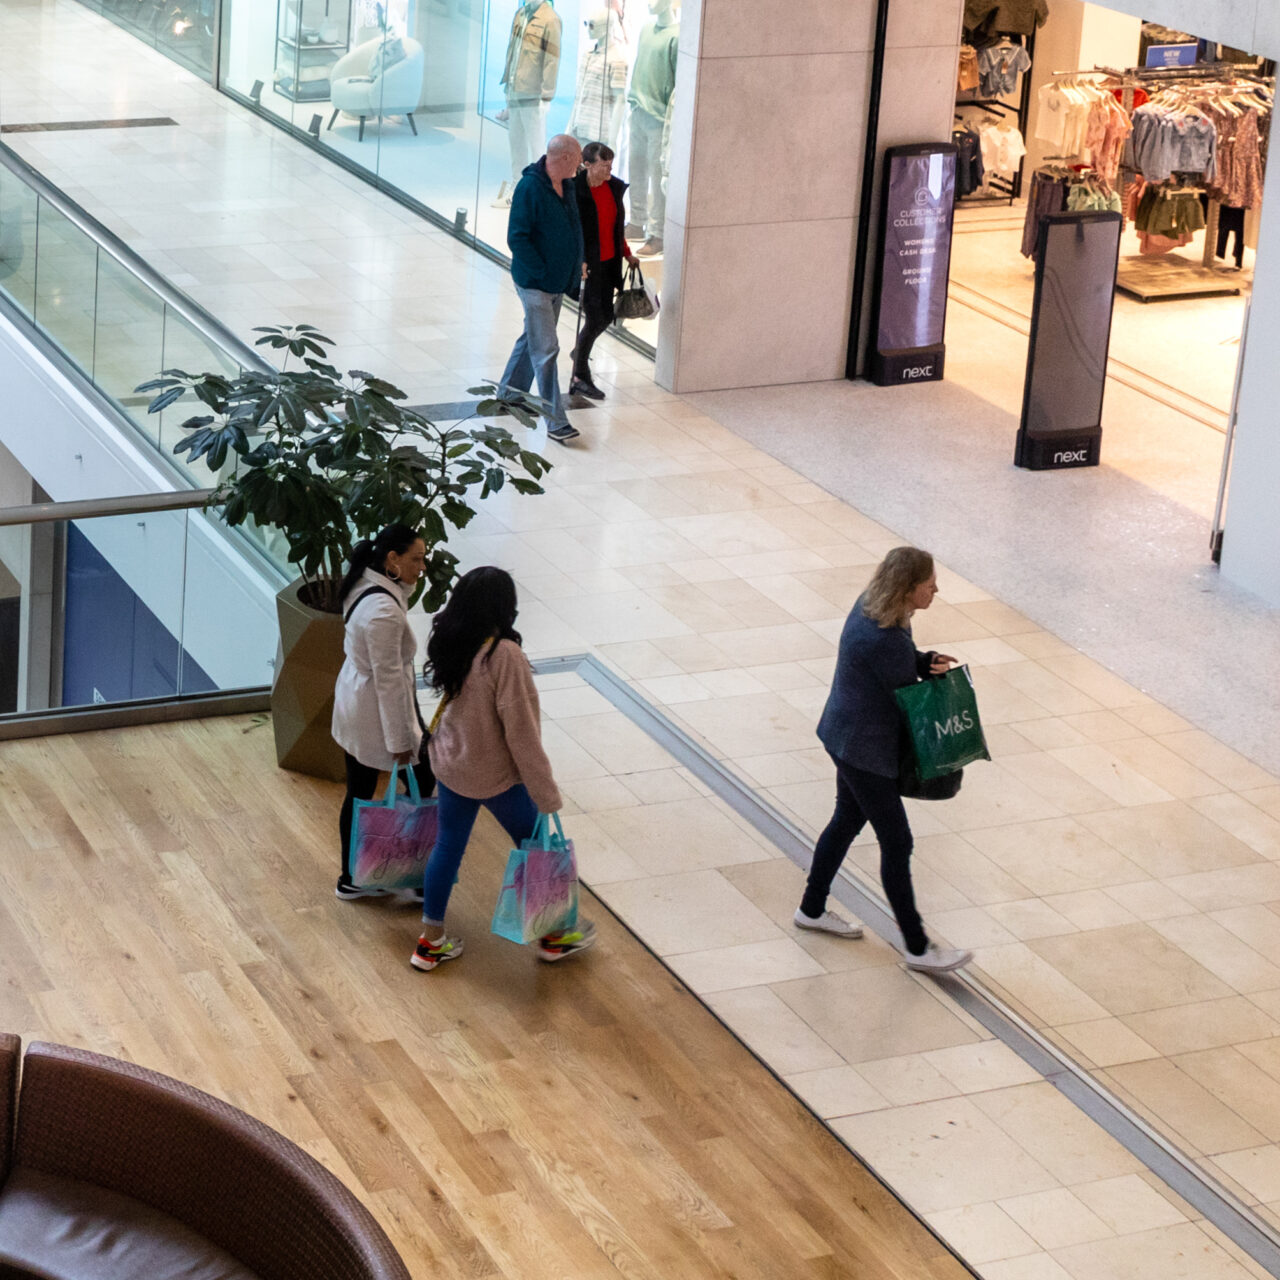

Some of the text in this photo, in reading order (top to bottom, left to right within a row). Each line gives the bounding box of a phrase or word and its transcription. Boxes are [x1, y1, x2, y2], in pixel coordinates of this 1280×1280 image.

[900, 208, 944, 218] CUSTOMER
[893, 215, 946, 227] COLLECTIONS
[900, 249, 918, 257] CASH
[902, 267, 932, 276] GROUND
[905, 277, 927, 286] FLOOR
[903, 365, 933, 379] next
[1053, 449, 1087, 464] next
[934, 710, 974, 740] M&S
